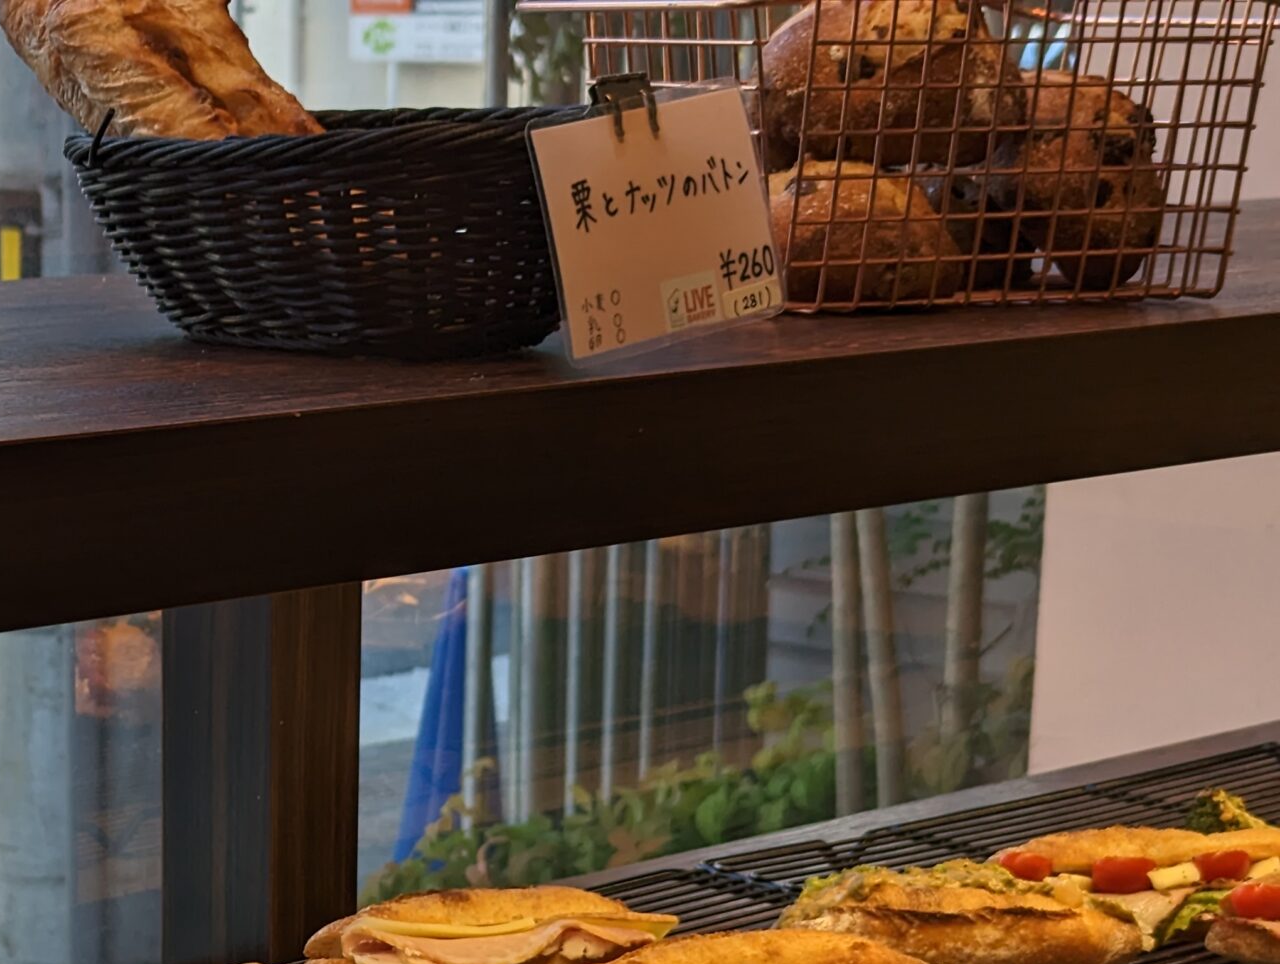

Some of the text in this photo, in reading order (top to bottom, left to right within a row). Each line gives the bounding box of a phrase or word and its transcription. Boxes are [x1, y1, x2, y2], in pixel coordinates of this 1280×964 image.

[571, 156, 750, 234] 栗とナッツのバトン
[720, 245, 776, 291] ¥260
[683, 285, 716, 314] LIVE
[733, 286, 772, 317] (281)
